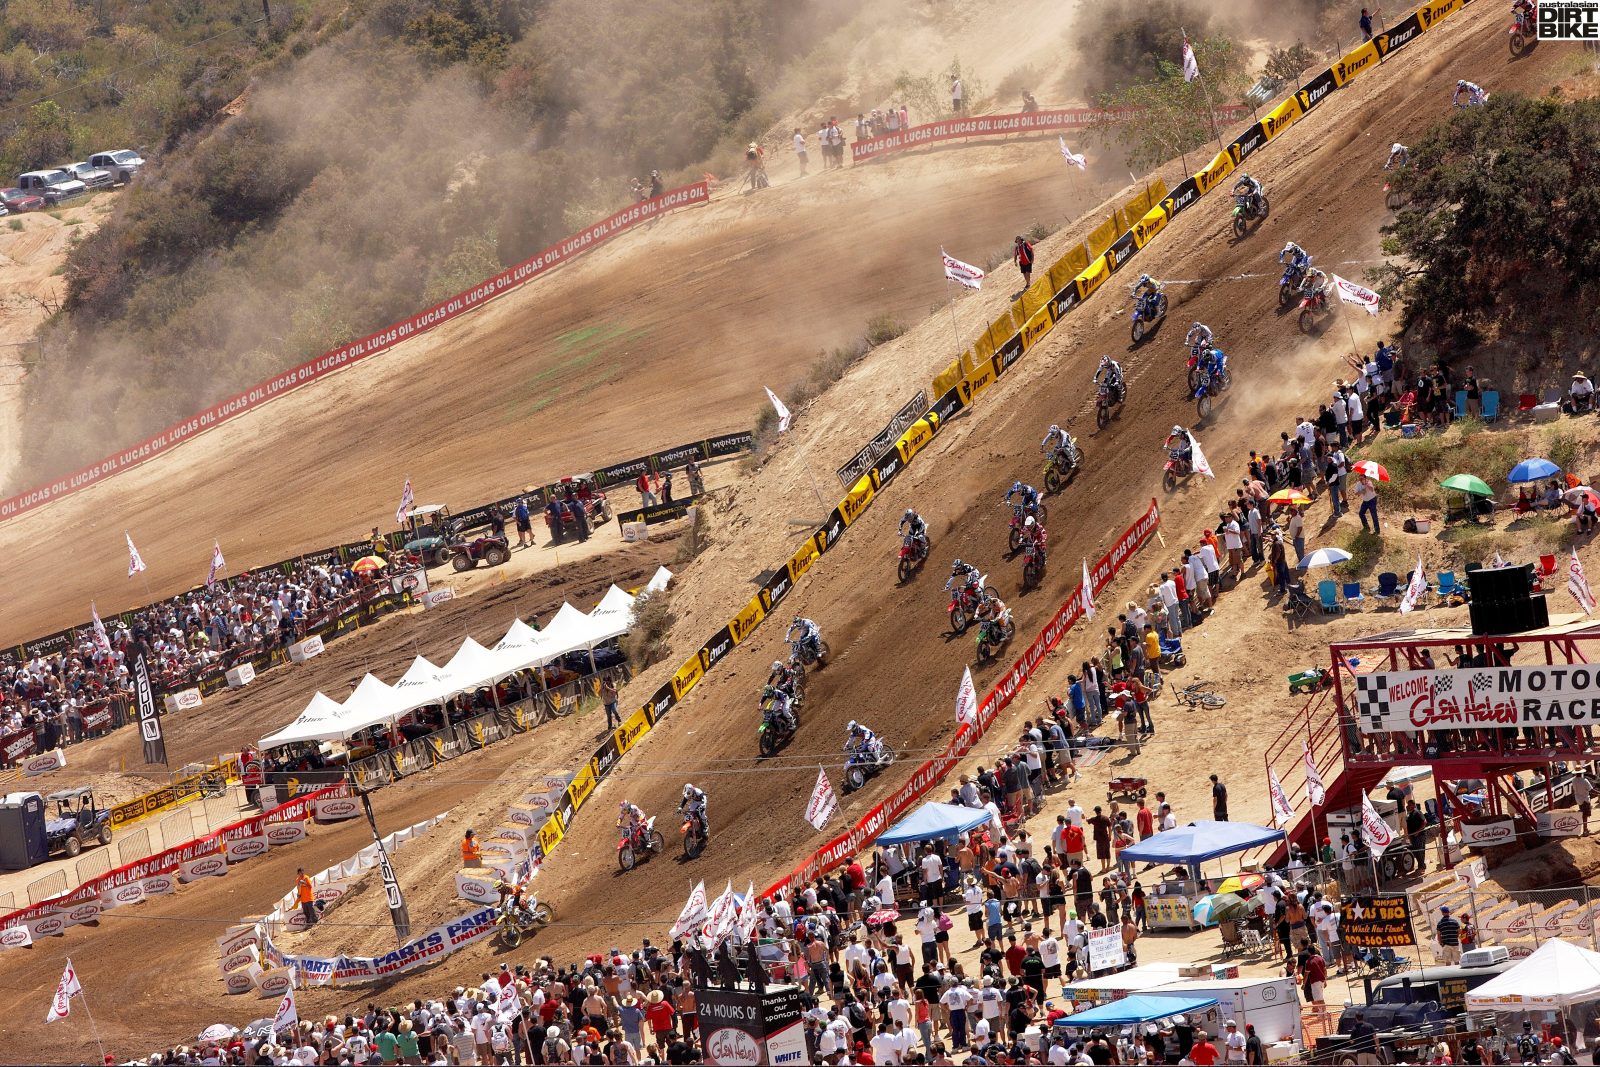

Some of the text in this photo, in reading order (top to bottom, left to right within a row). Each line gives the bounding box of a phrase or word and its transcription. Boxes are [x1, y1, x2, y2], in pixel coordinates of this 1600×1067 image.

[855, 141, 884, 156] LUCAS
[886, 137, 901, 150] OIL
[904, 128, 932, 144] LUCAS
[934, 125, 948, 137] OIL
[950, 120, 977, 134] LUCAS
[978, 119, 992, 130] OIL
[993, 116, 1020, 130] LUCAS
[1022, 116, 1034, 126] OIL
[1036, 114, 1062, 125] LUCAS
[2, 186, 705, 515] OIL LUCAS OIL LUCAS OIL LUCAS OIL LUCAS OIL LUCAS OIL LUCAS OIL LUCAS OIL LUCAS OIL LUCAS OIL LUCAS OIL LUCAS OIL LUCAS OIL LUCAS OIL LUCAS OIL
[660, 447, 699, 463] MONSTER
[607, 462, 647, 477] MONSTER
[1388, 676, 1428, 703] WELCOME
[1499, 669, 1600, 693] MOTO
[4, 732, 34, 754] WORKS
[115, 872, 126, 886] OIL
[128, 863, 149, 880] LUCAS
[150, 860, 160, 873] OIL
[162, 850, 182, 868] LUCAS
[182, 846, 194, 861] OIL
[194, 838, 214, 858] LUCAS
[222, 826, 242, 844] LUCAS
[244, 823, 253, 837] OIL
[283, 802, 304, 820] LUCAS
[1380, 907, 1406, 920] BBQ
[373, 932, 442, 968] PARTS
[446, 908, 496, 938] PART
[376, 944, 445, 975] UNLIMITED
[700, 1002, 757, 1020] 24 HOURS OF
[762, 996, 787, 1006] Thanks
[765, 1010, 800, 1022] sponsors
[774, 1050, 802, 1064] WHITE
